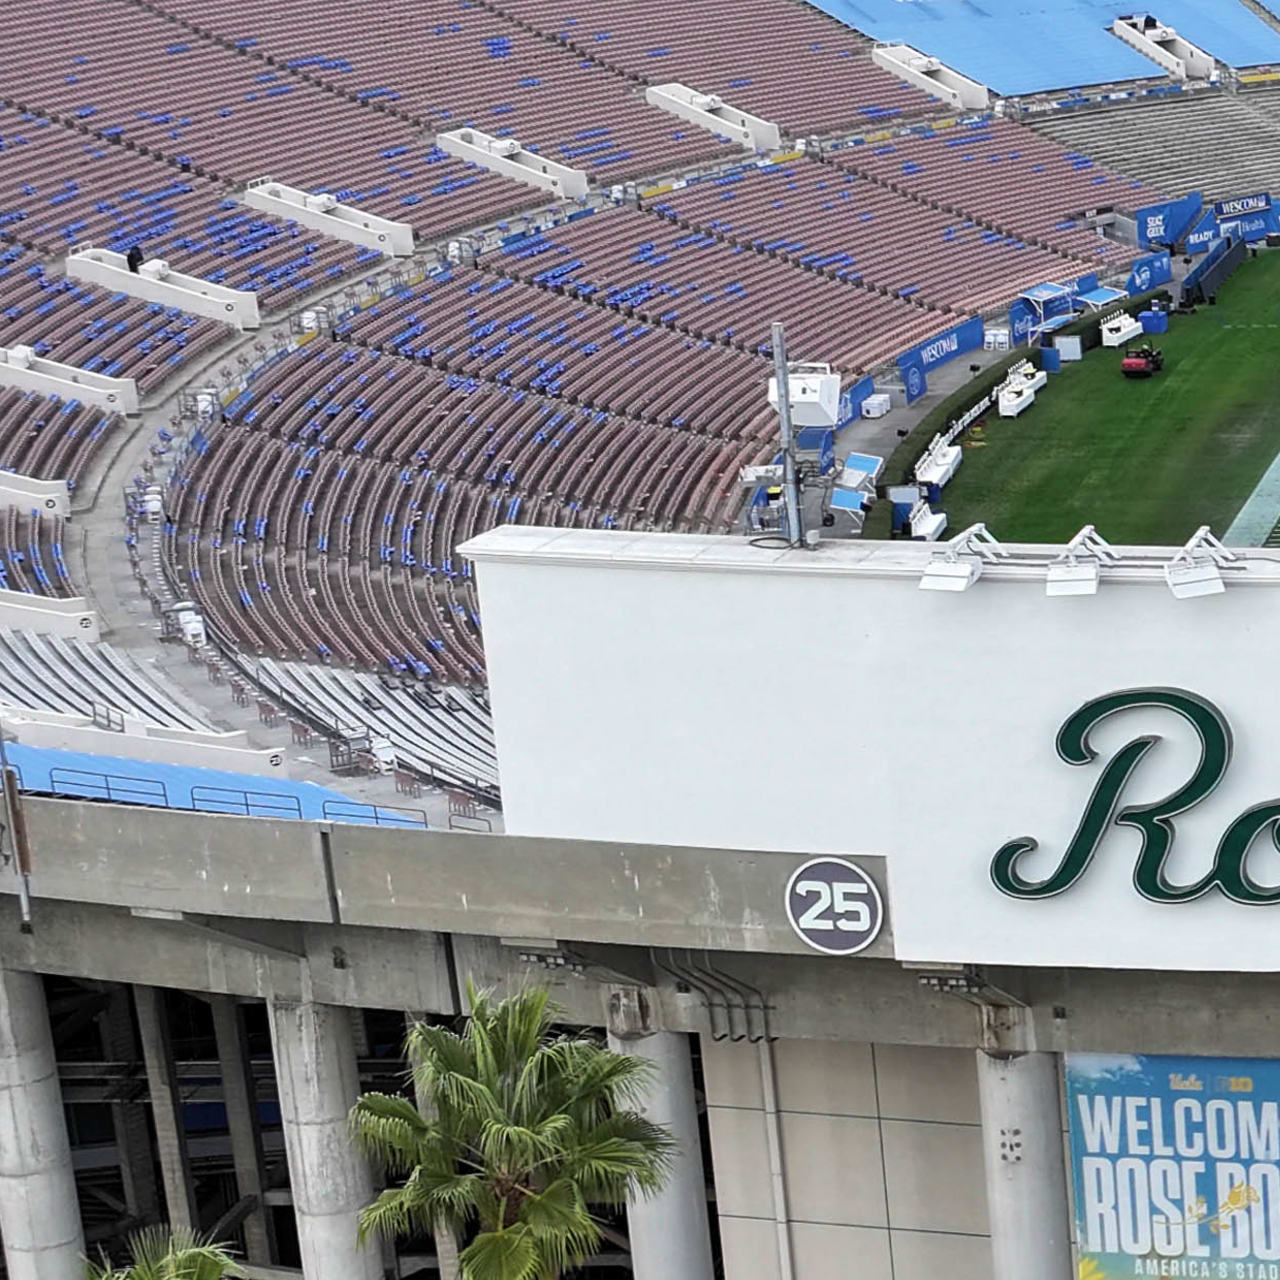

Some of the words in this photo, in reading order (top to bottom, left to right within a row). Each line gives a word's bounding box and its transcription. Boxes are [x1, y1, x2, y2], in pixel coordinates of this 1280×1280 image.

[1221, 194, 1259, 214] WESCOM
[921, 338, 951, 365] WESCOM
[795, 879, 871, 932] 25
[1082, 1157, 1210, 1258] ROSE
[1134, 1258, 1229, 1279] AMERICA'S
